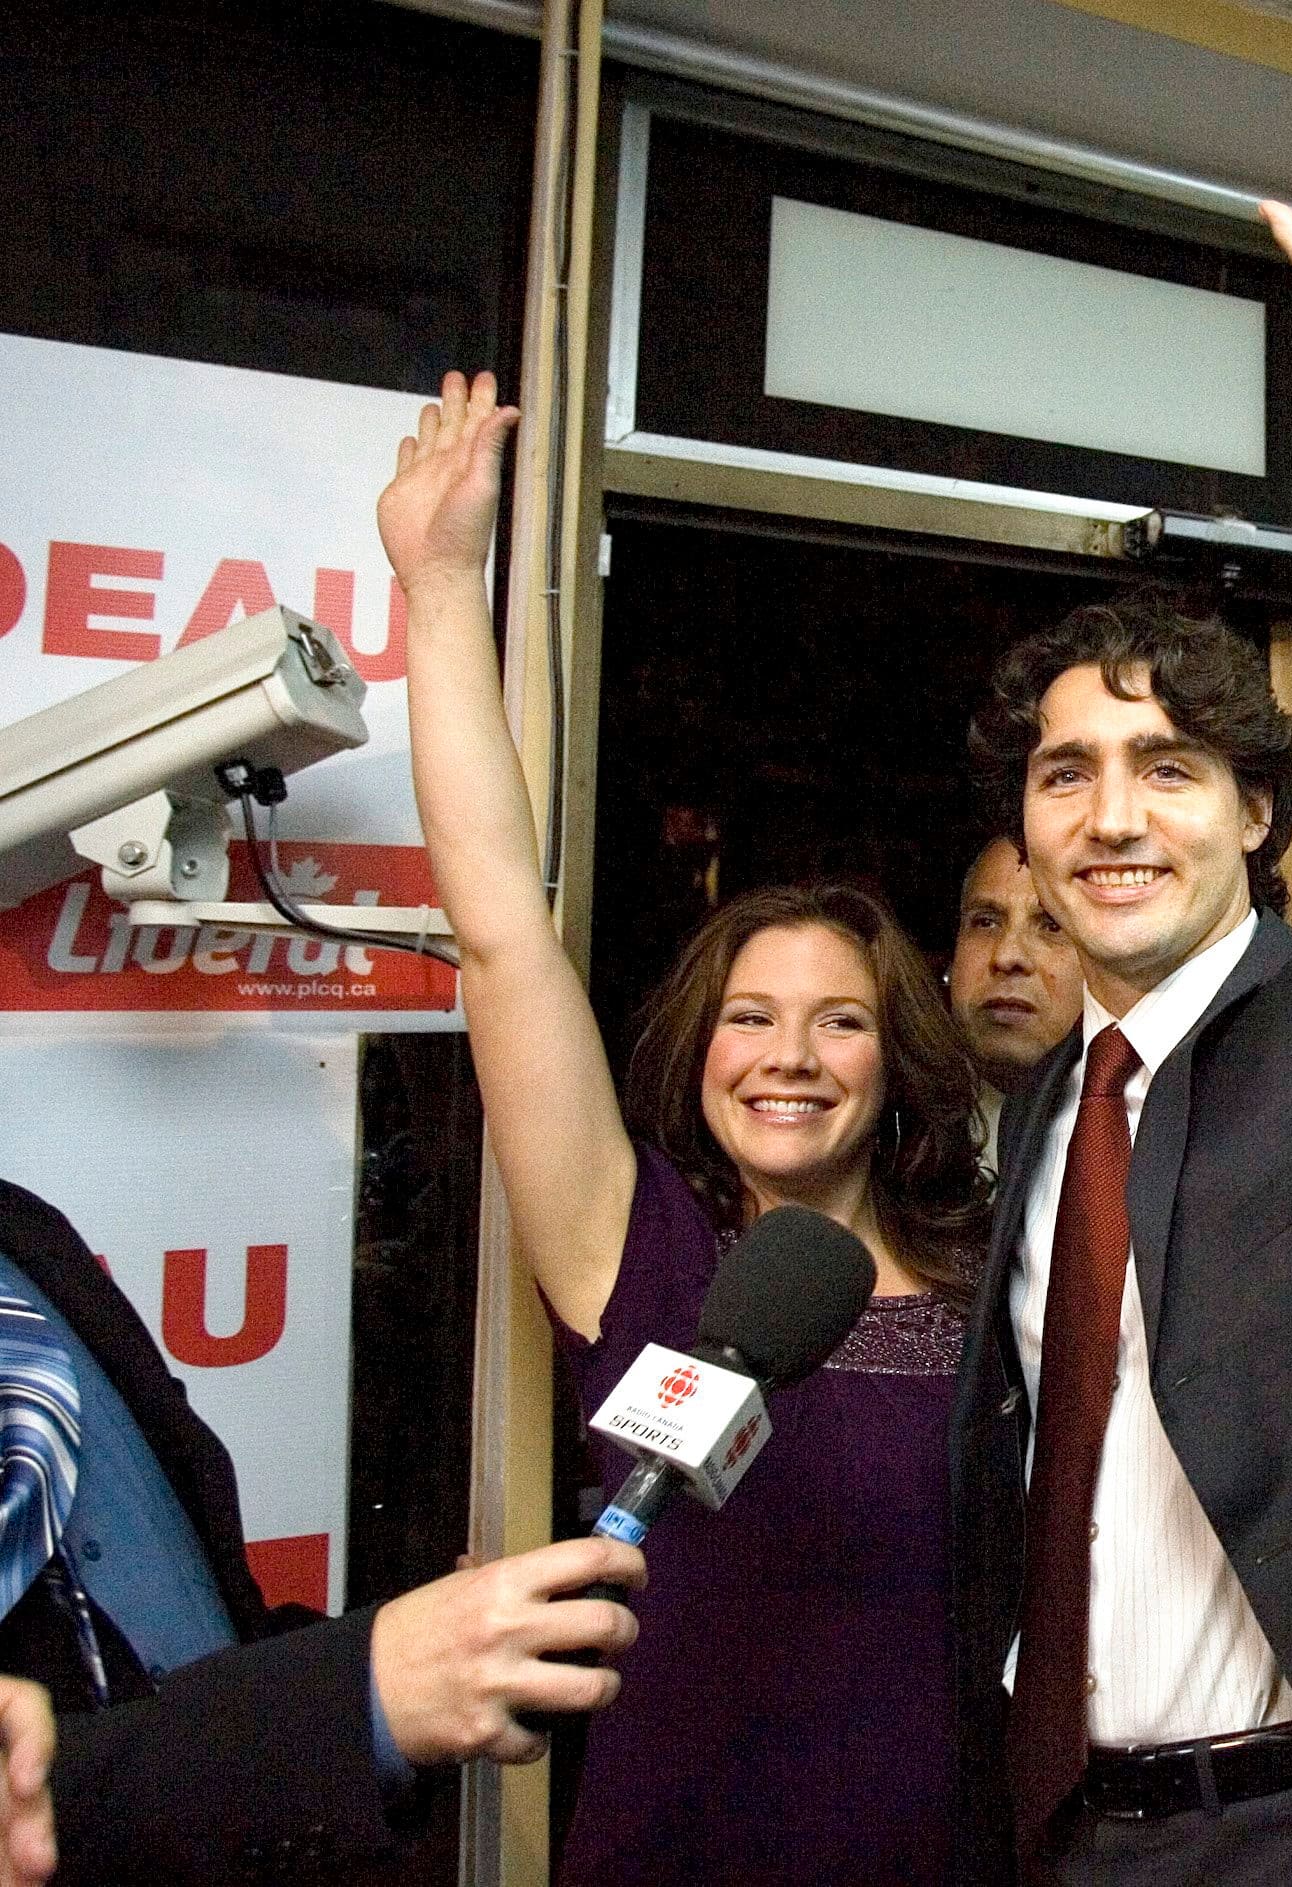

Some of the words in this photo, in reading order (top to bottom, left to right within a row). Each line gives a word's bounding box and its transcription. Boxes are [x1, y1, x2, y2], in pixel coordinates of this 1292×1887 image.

[0, 541, 408, 682] EAU
[237, 979, 377, 999] www.plcq.ca
[608, 1414, 683, 1451] SPORTS
